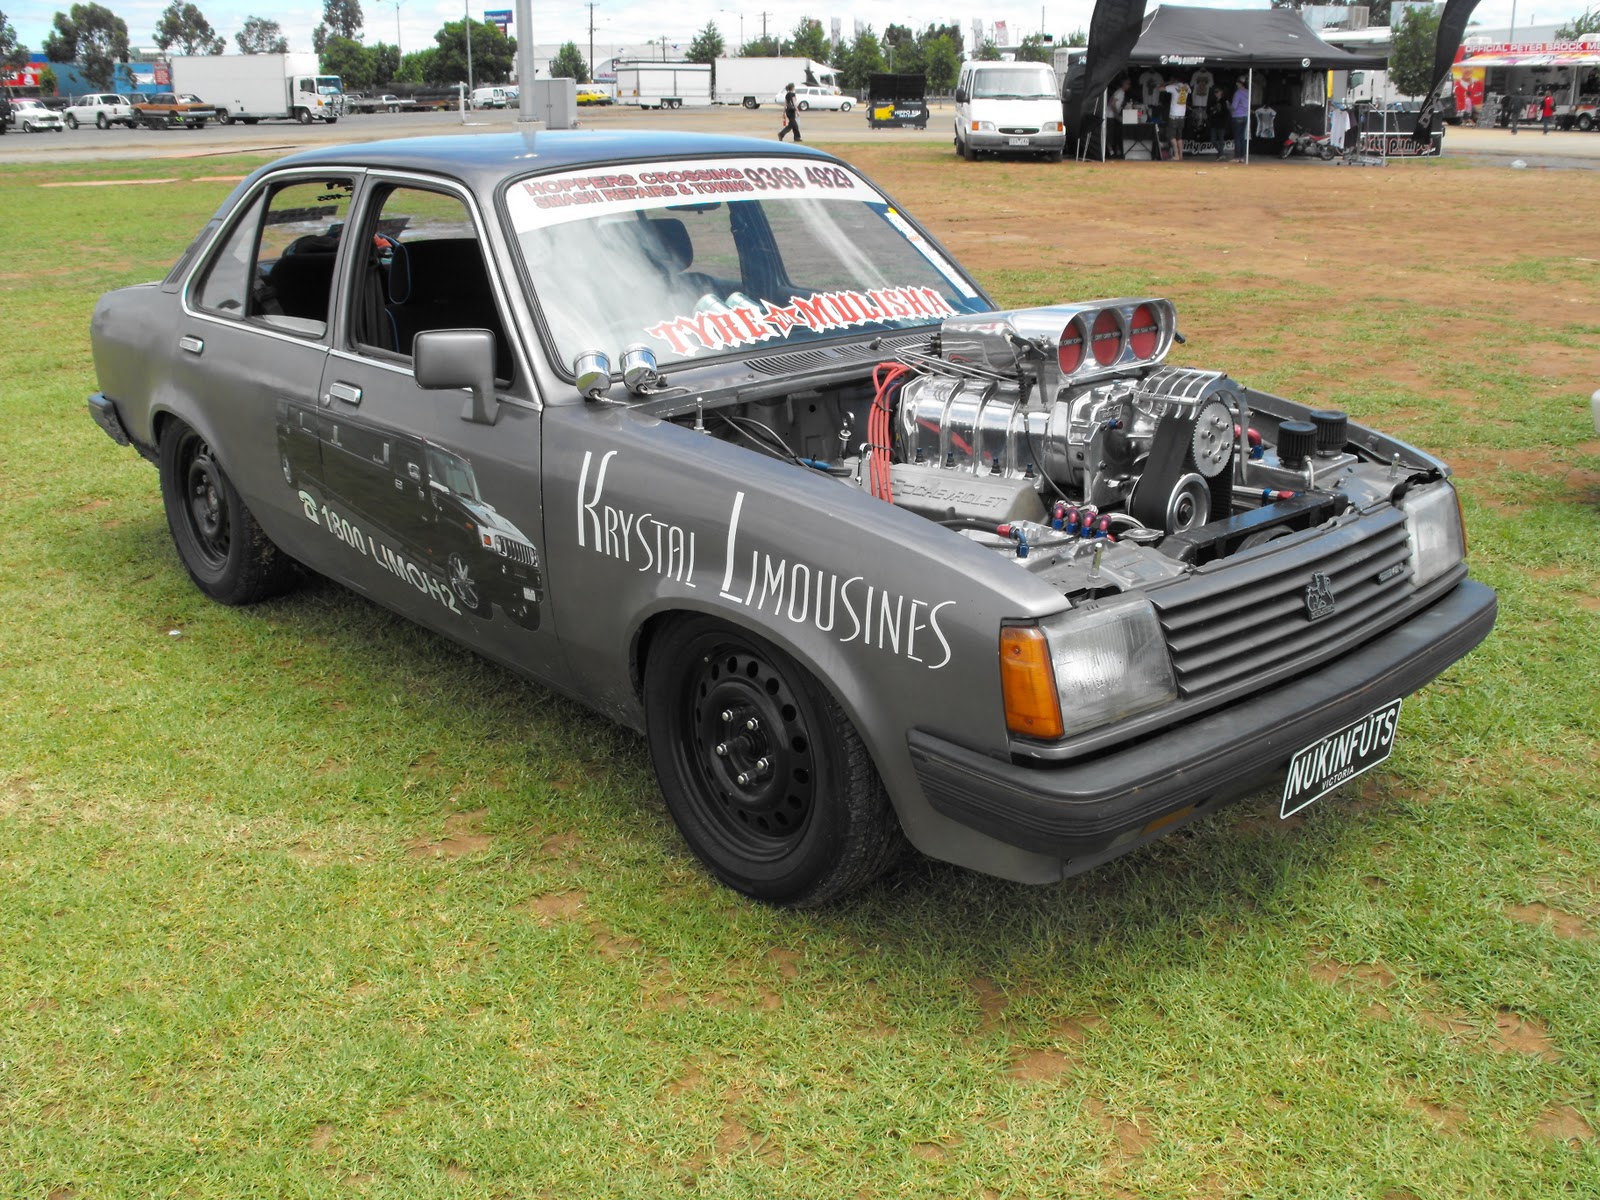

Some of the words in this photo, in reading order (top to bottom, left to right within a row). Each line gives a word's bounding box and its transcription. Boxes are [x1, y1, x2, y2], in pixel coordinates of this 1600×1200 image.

[1465, 44, 1508, 53] OFFICIAL
[1511, 43, 1544, 52] PETER
[1546, 42, 1583, 51] BROCK
[1182, 139, 1200, 154] irty
[523, 174, 637, 196] HOPPERS
[639, 167, 744, 184] CROSSING
[743, 166, 806, 191] 9369
[804, 166, 855, 189] 4929
[533, 190, 604, 209] SMASH
[601, 184, 678, 202] REPAIRS
[676, 183, 693, 196] &
[689, 179, 755, 195] TOWING
[646, 304, 774, 356] TYRE
[790, 286, 955, 331] MULISHA
[913, 486, 1008, 508] CHEVROLET
[321, 504, 368, 556] 1800
[368, 535, 462, 616] LIMOH2
[577, 450, 696, 588] KRYSTAL
[719, 491, 956, 669] LIMOUSINES
[1287, 707, 1396, 800] NUKINFUTS
[1321, 765, 1355, 790] VICTORIA
